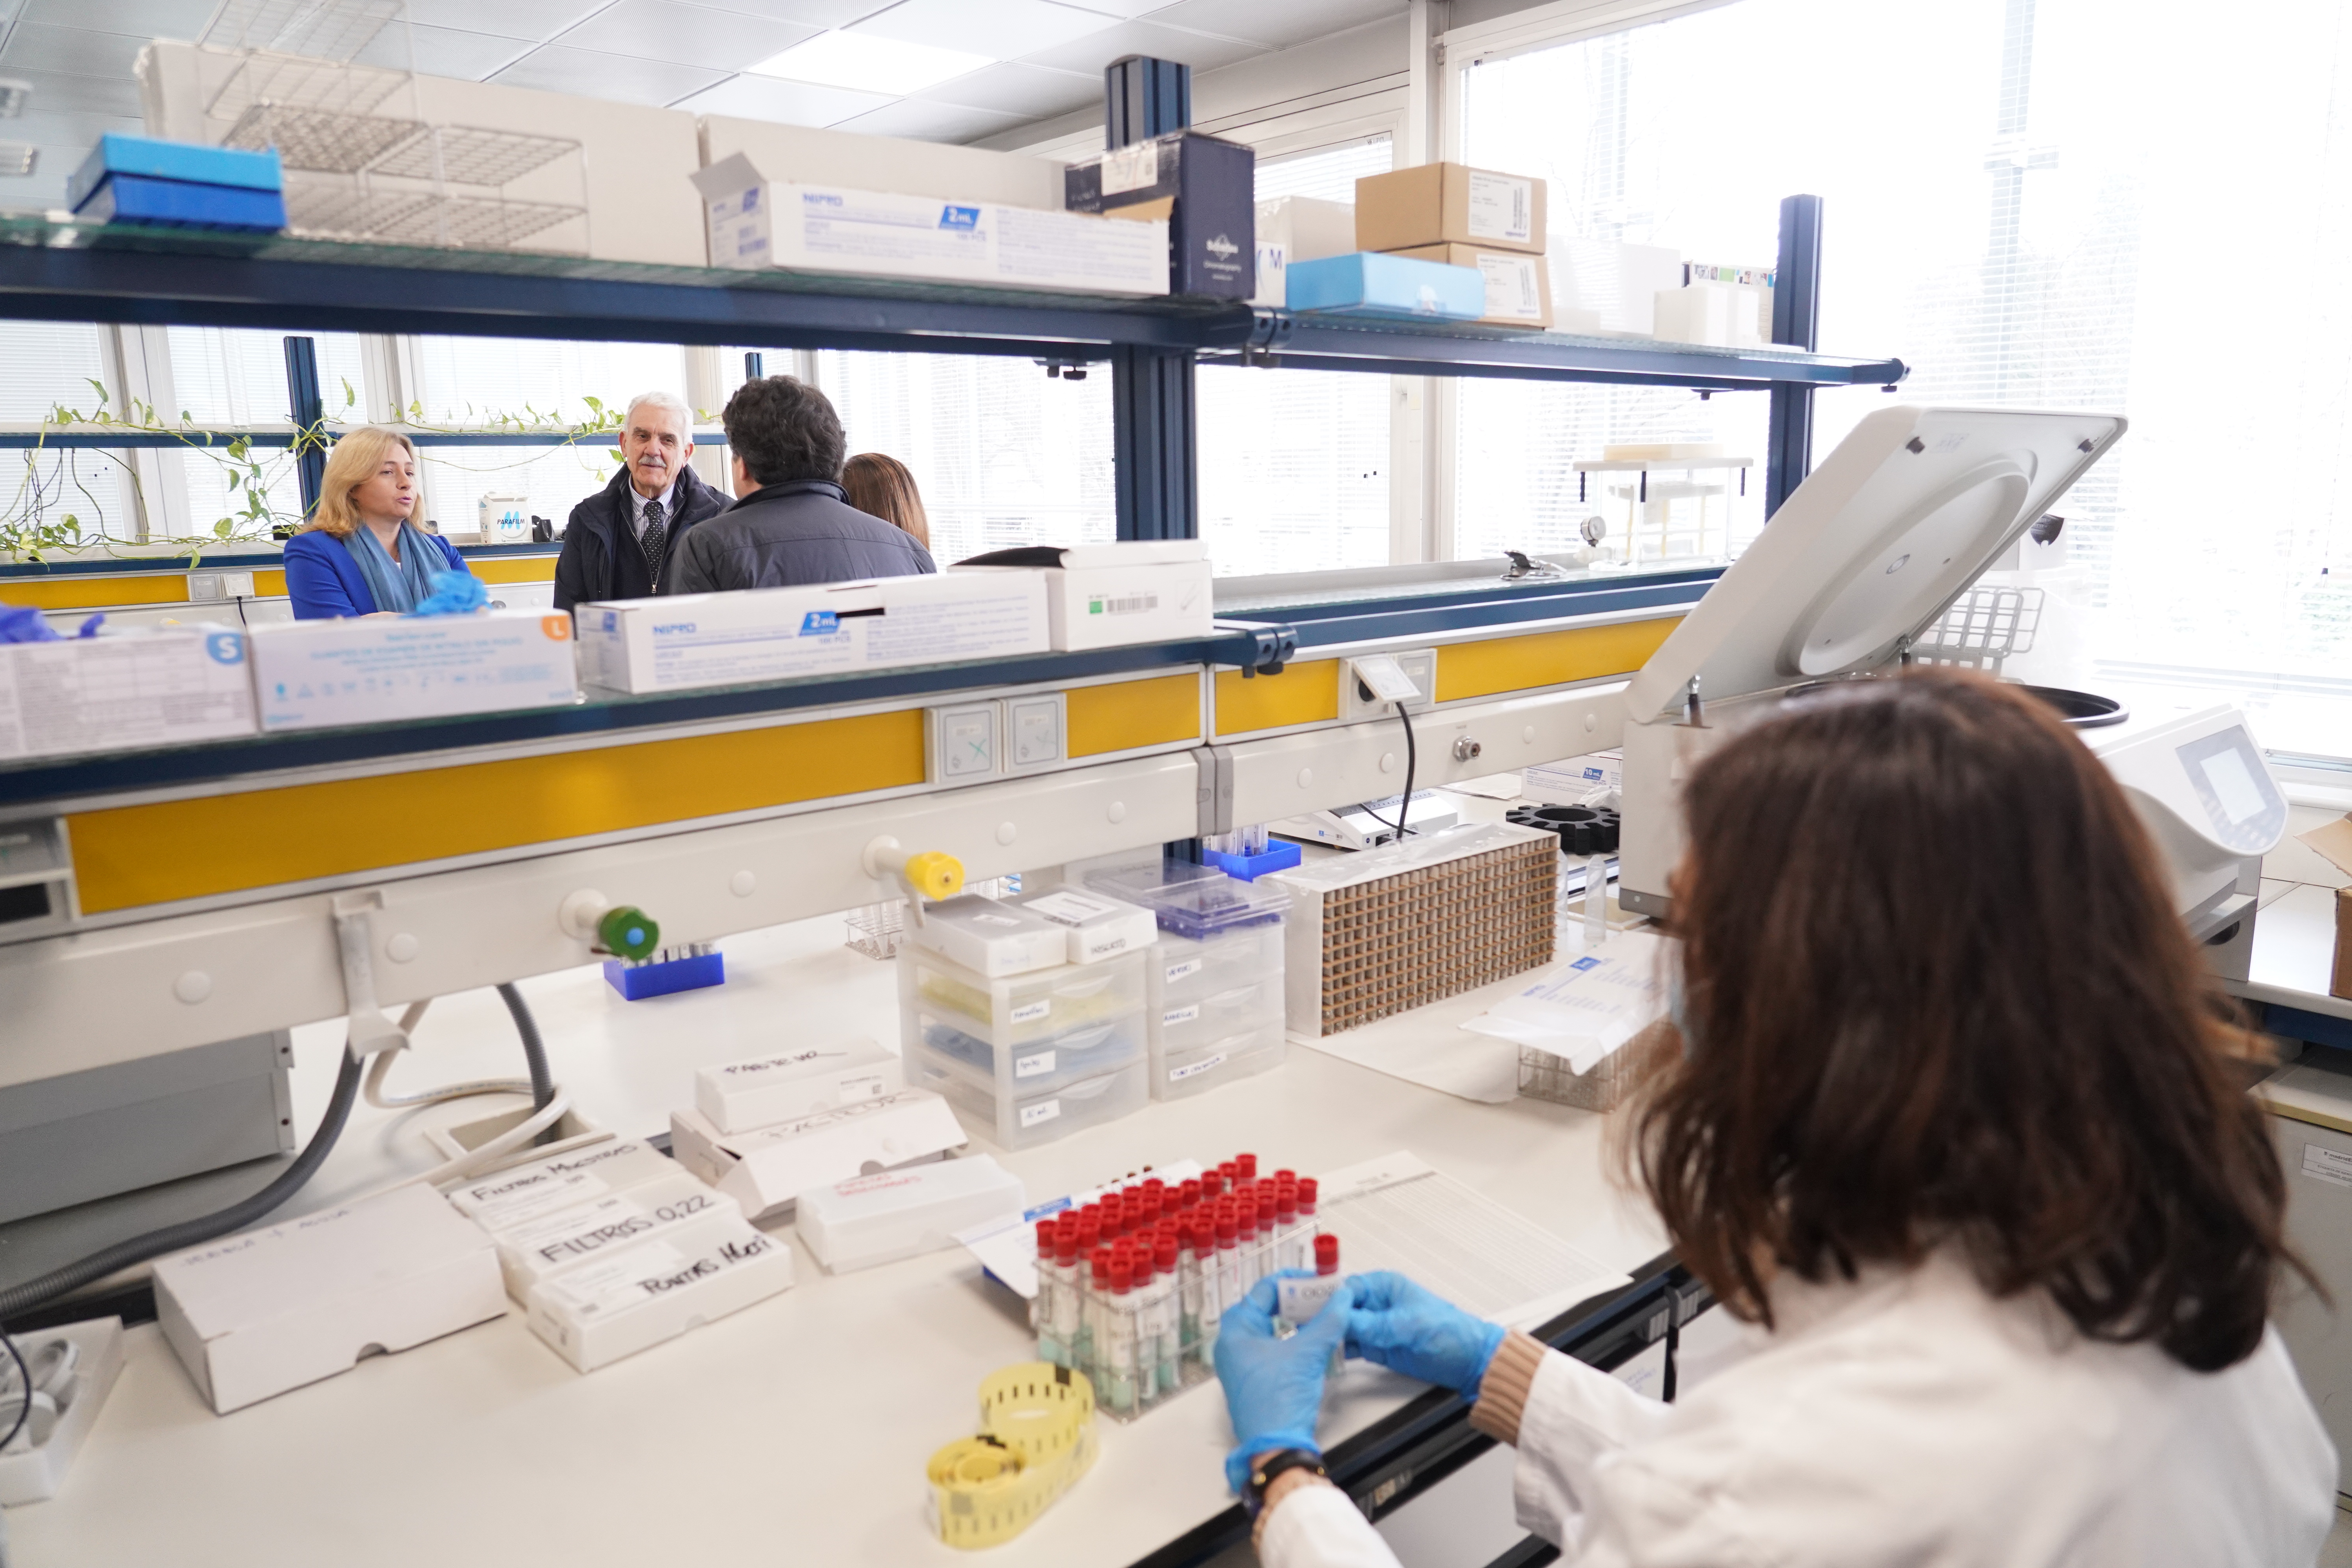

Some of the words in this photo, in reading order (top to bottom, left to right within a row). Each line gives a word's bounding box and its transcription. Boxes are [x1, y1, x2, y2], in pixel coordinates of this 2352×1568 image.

[553, 621, 563, 635] L
[653, 622, 696, 635] NIPRO
[217, 636, 237, 659] S
